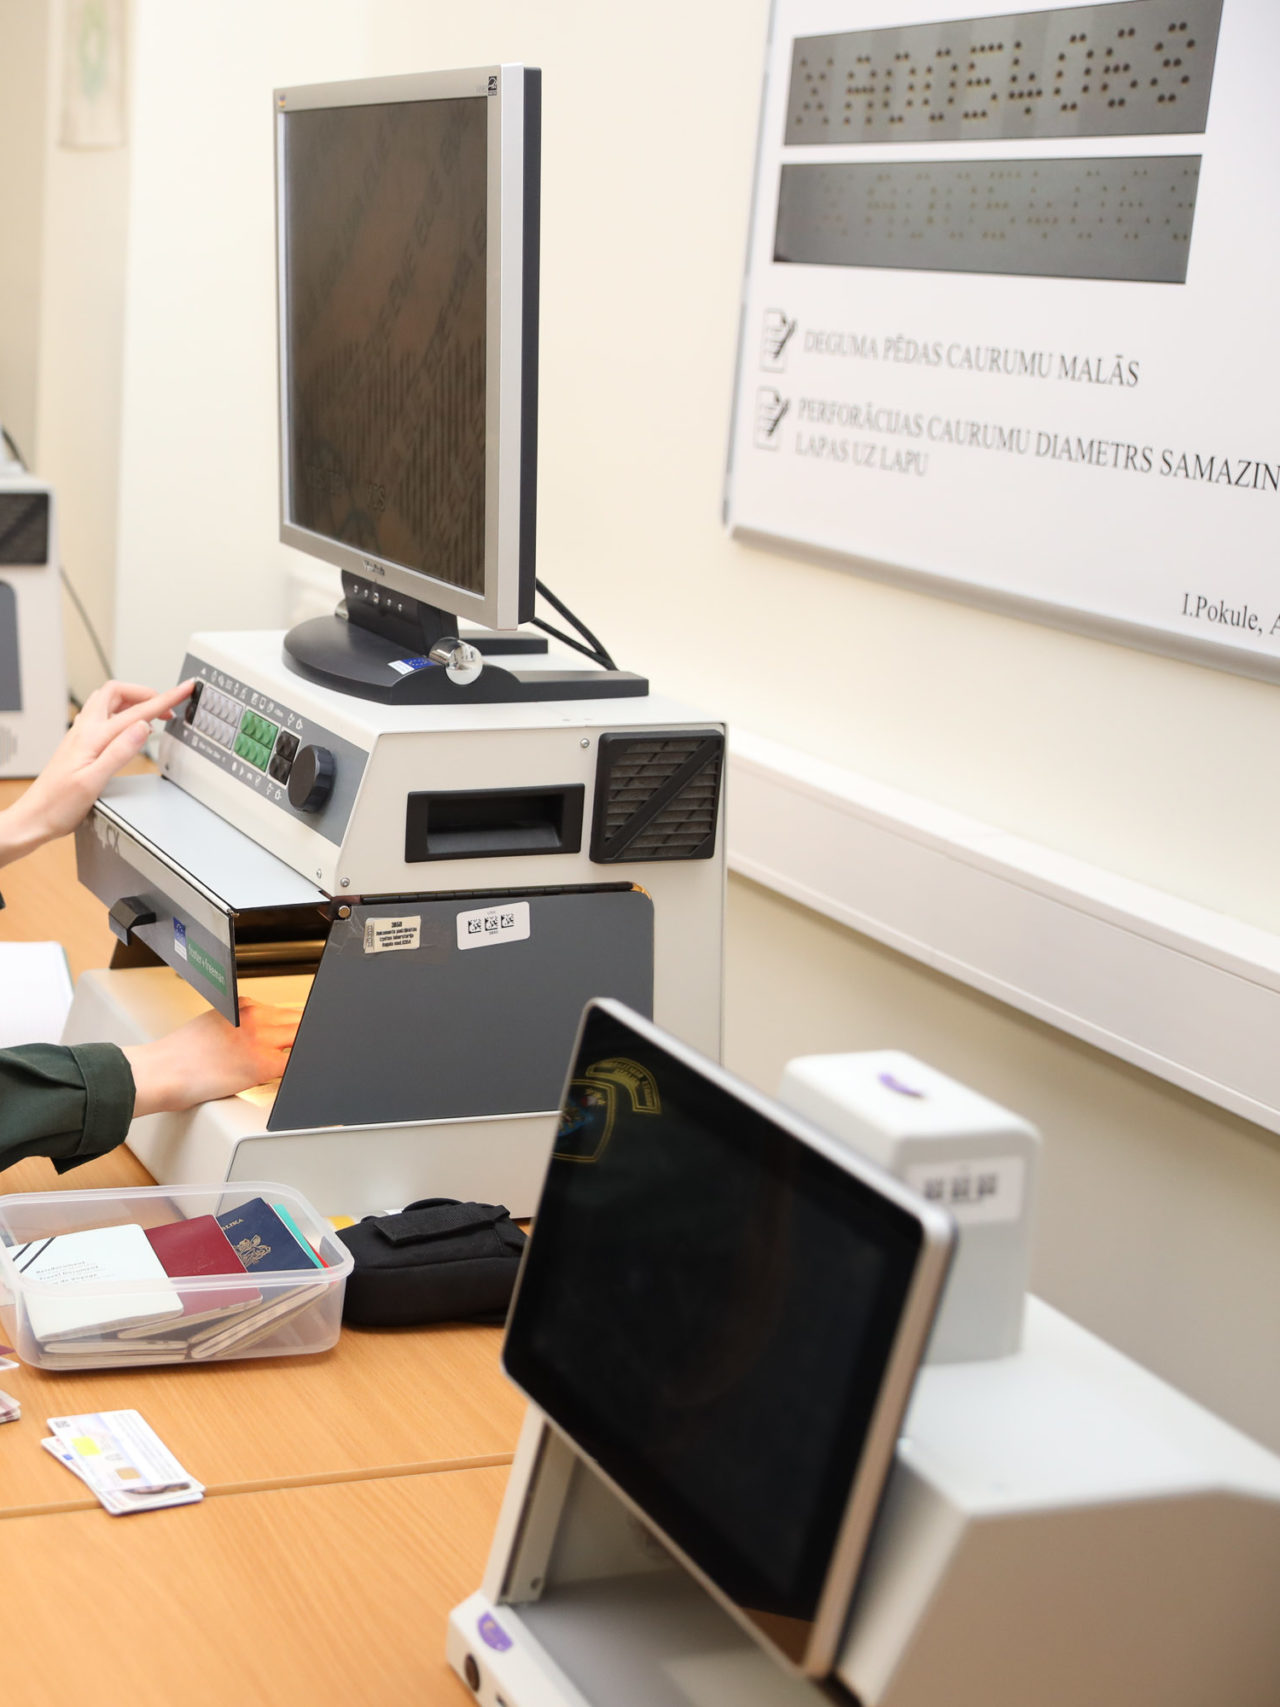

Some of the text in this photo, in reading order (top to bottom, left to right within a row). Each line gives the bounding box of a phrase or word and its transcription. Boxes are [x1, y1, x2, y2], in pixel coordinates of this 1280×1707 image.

[804, 329, 1140, 388] DEGUMA PĒDAS CAURUMU MALĀS
[795, 431, 928, 477] LAPAS UZ LAPU
[797, 397, 923, 439] PERFORĀCIJAS
[927, 415, 1030, 456] CAURUMU
[1035, 431, 1153, 474] DIAMETRS
[1182, 593, 1262, 637] I.Pokule,
